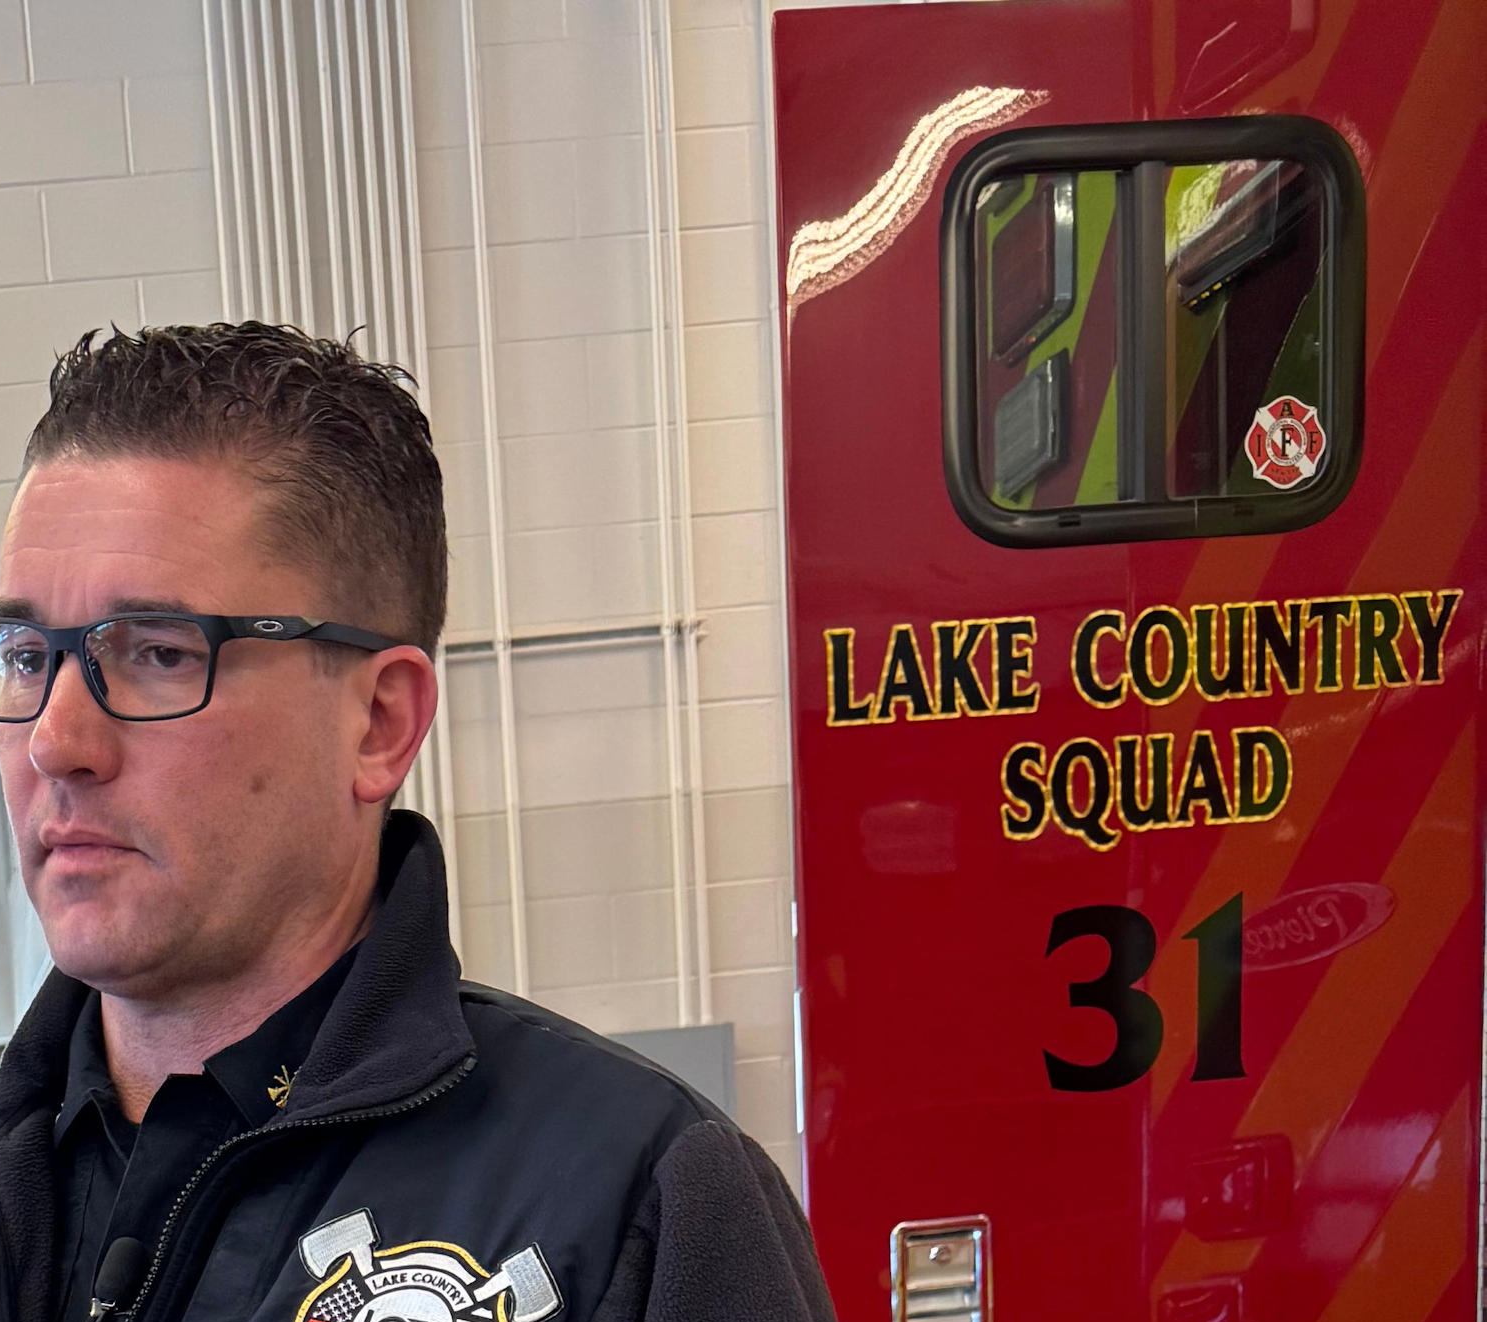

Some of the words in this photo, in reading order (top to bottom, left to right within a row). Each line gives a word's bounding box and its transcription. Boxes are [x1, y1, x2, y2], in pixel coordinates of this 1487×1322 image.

[824, 616, 1041, 727] LAKE
[1071, 590, 1464, 708] COUNTRY
[1001, 726, 1293, 852] SQUAD
[1042, 891, 1248, 1093] 31
[372, 1272, 408, 1291] LAKE
[411, 1272, 467, 1306] COUNTRY
